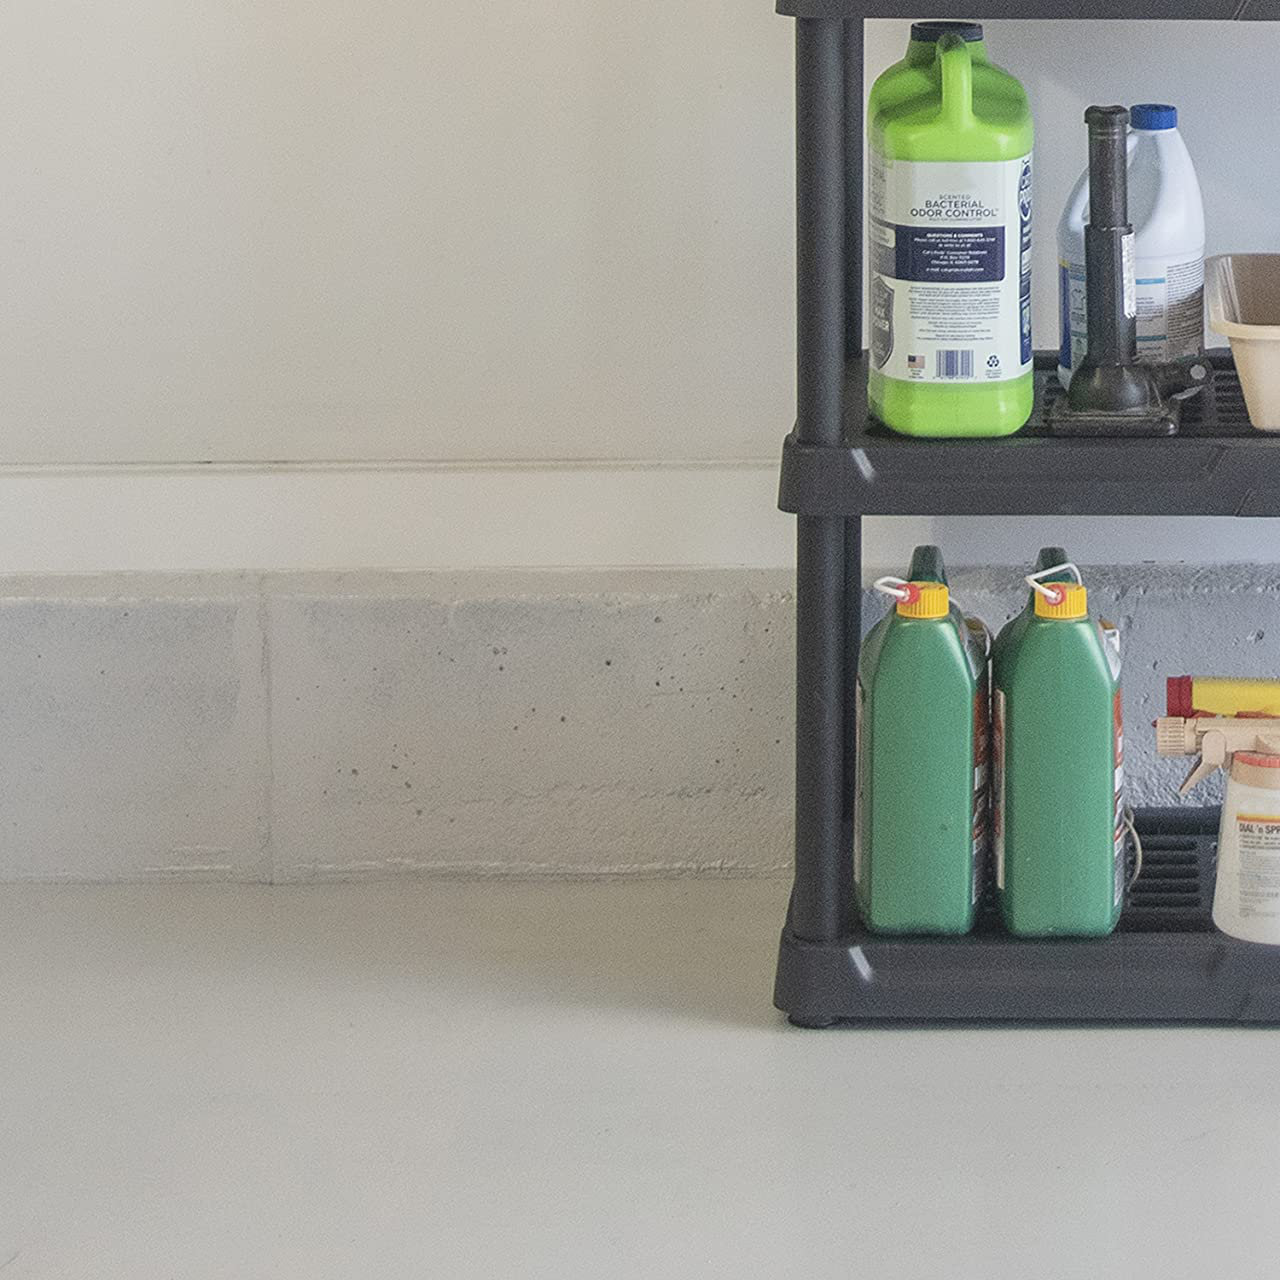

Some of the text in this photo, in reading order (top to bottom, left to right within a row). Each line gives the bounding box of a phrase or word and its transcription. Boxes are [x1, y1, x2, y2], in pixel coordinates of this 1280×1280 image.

[925, 200, 984, 208] BACTERIAL
[910, 208, 942, 217] ODOR
[1239, 823, 1255, 833] DIAL
